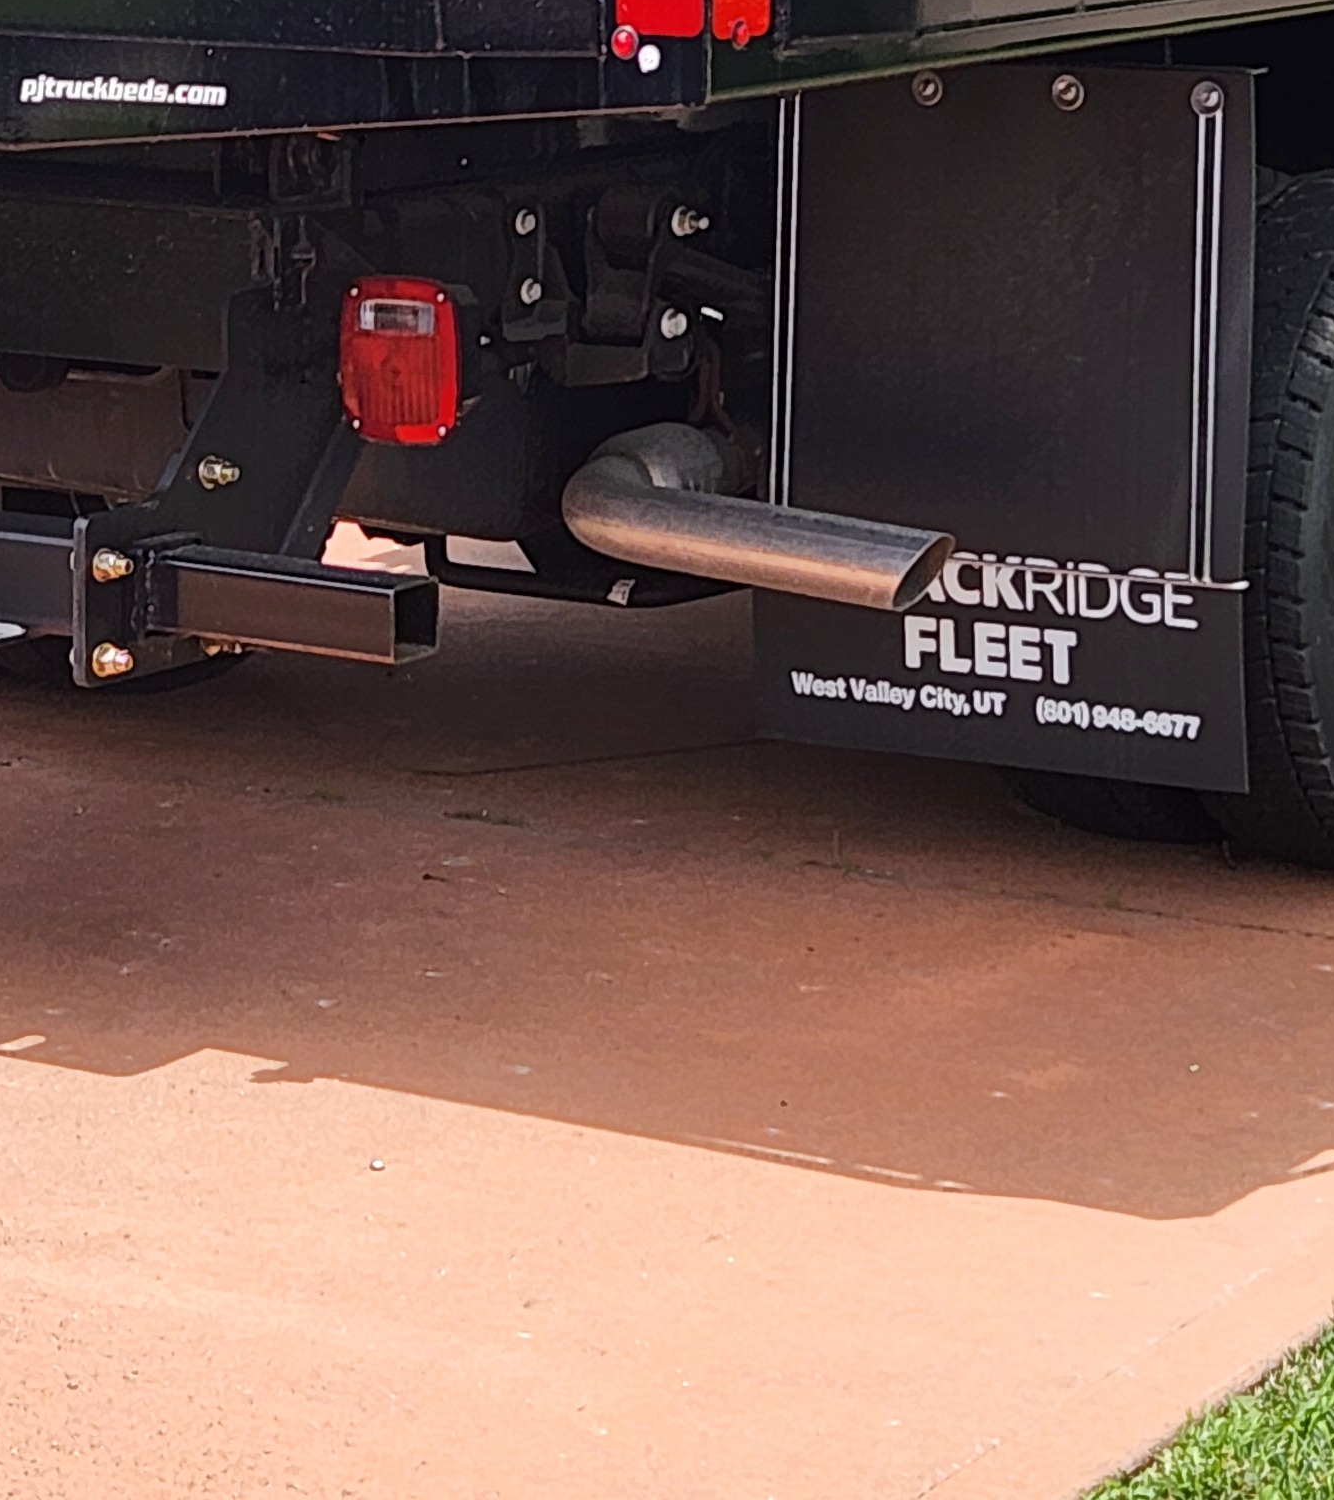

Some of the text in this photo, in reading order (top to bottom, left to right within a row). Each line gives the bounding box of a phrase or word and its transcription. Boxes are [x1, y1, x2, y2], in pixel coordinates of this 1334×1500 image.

[20, 74, 227, 106] pjtruckbeds.com
[904, 615, 1078, 685] FLEET
[791, 671, 1201, 740] West Valley City, UT (801) 948-6677
